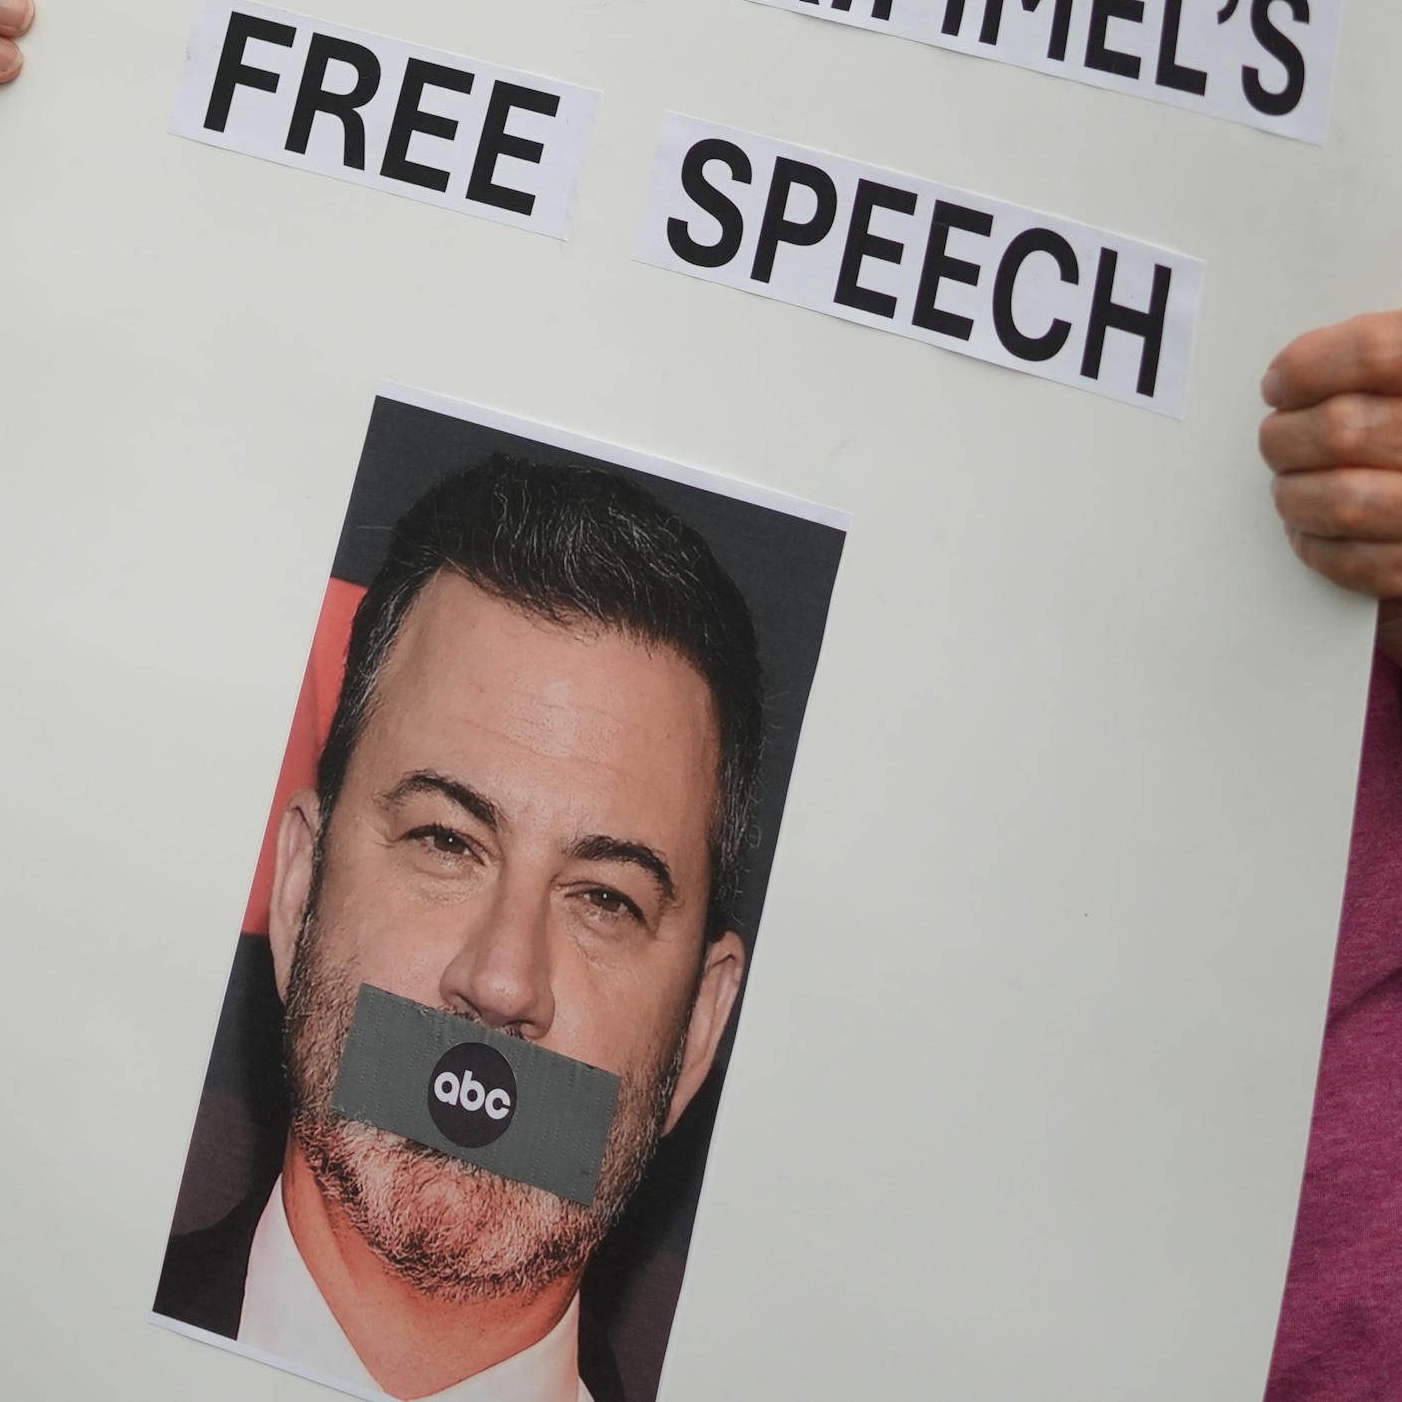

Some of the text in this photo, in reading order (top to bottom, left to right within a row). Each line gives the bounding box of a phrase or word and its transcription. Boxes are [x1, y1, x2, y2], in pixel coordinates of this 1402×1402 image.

[203, 11, 1172, 398] FREE SPEECH
[434, 1069, 511, 1120] abc
